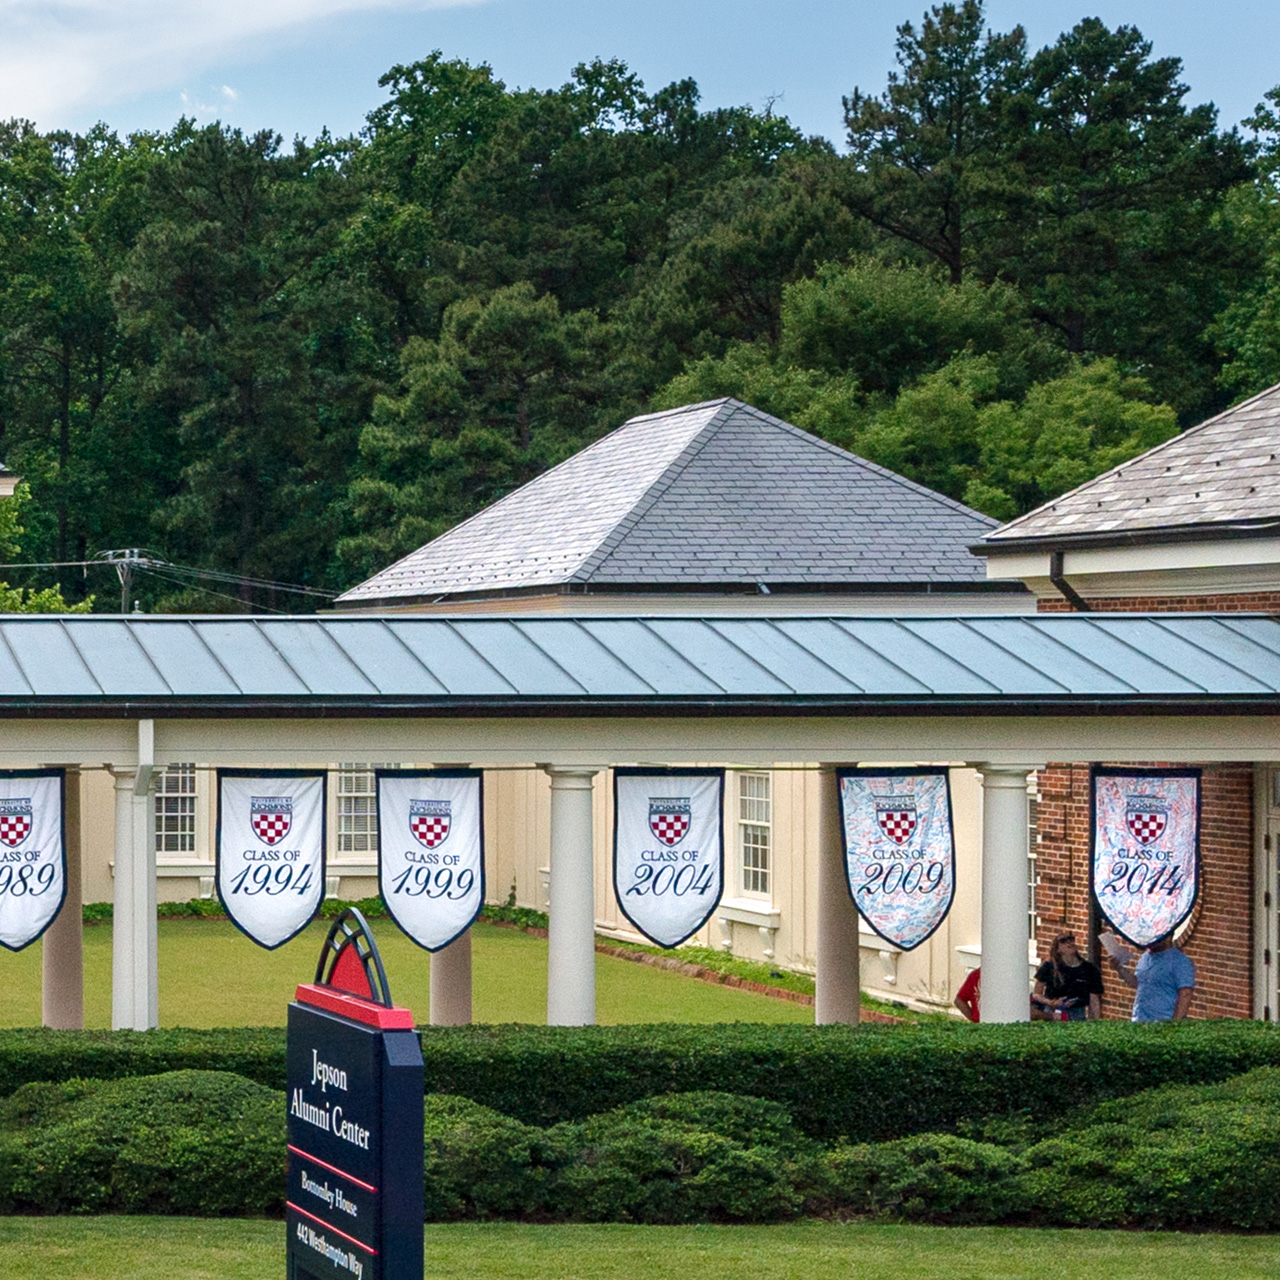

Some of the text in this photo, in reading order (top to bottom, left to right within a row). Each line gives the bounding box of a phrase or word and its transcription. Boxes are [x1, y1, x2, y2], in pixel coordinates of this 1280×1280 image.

[251, 803, 292, 811] RICHMOND
[411, 806, 451, 815] RICHMOND
[650, 804, 690, 812] RICHMOND
[25, 851, 40, 861] OF
[243, 850, 300, 861] CLASS OF
[405, 851, 459, 865] CLASS OF
[641, 851, 698, 861] CLASS OF
[873, 849, 926, 860] CLASS OF
[1118, 848, 1173, 861] CLASS OF
[231, 864, 313, 895] 1994
[392, 865, 474, 900] 1999
[626, 864, 713, 896] 2004
[858, 862, 944, 894] 2009
[1102, 862, 1181, 896] 2014
[311, 1048, 348, 1093] Jepson
[290, 1087, 370, 1150] Alumni Center
[335, 1188, 358, 1217] House
[296, 1222, 308, 1245] 442
[348, 1251, 363, 1280] Way
